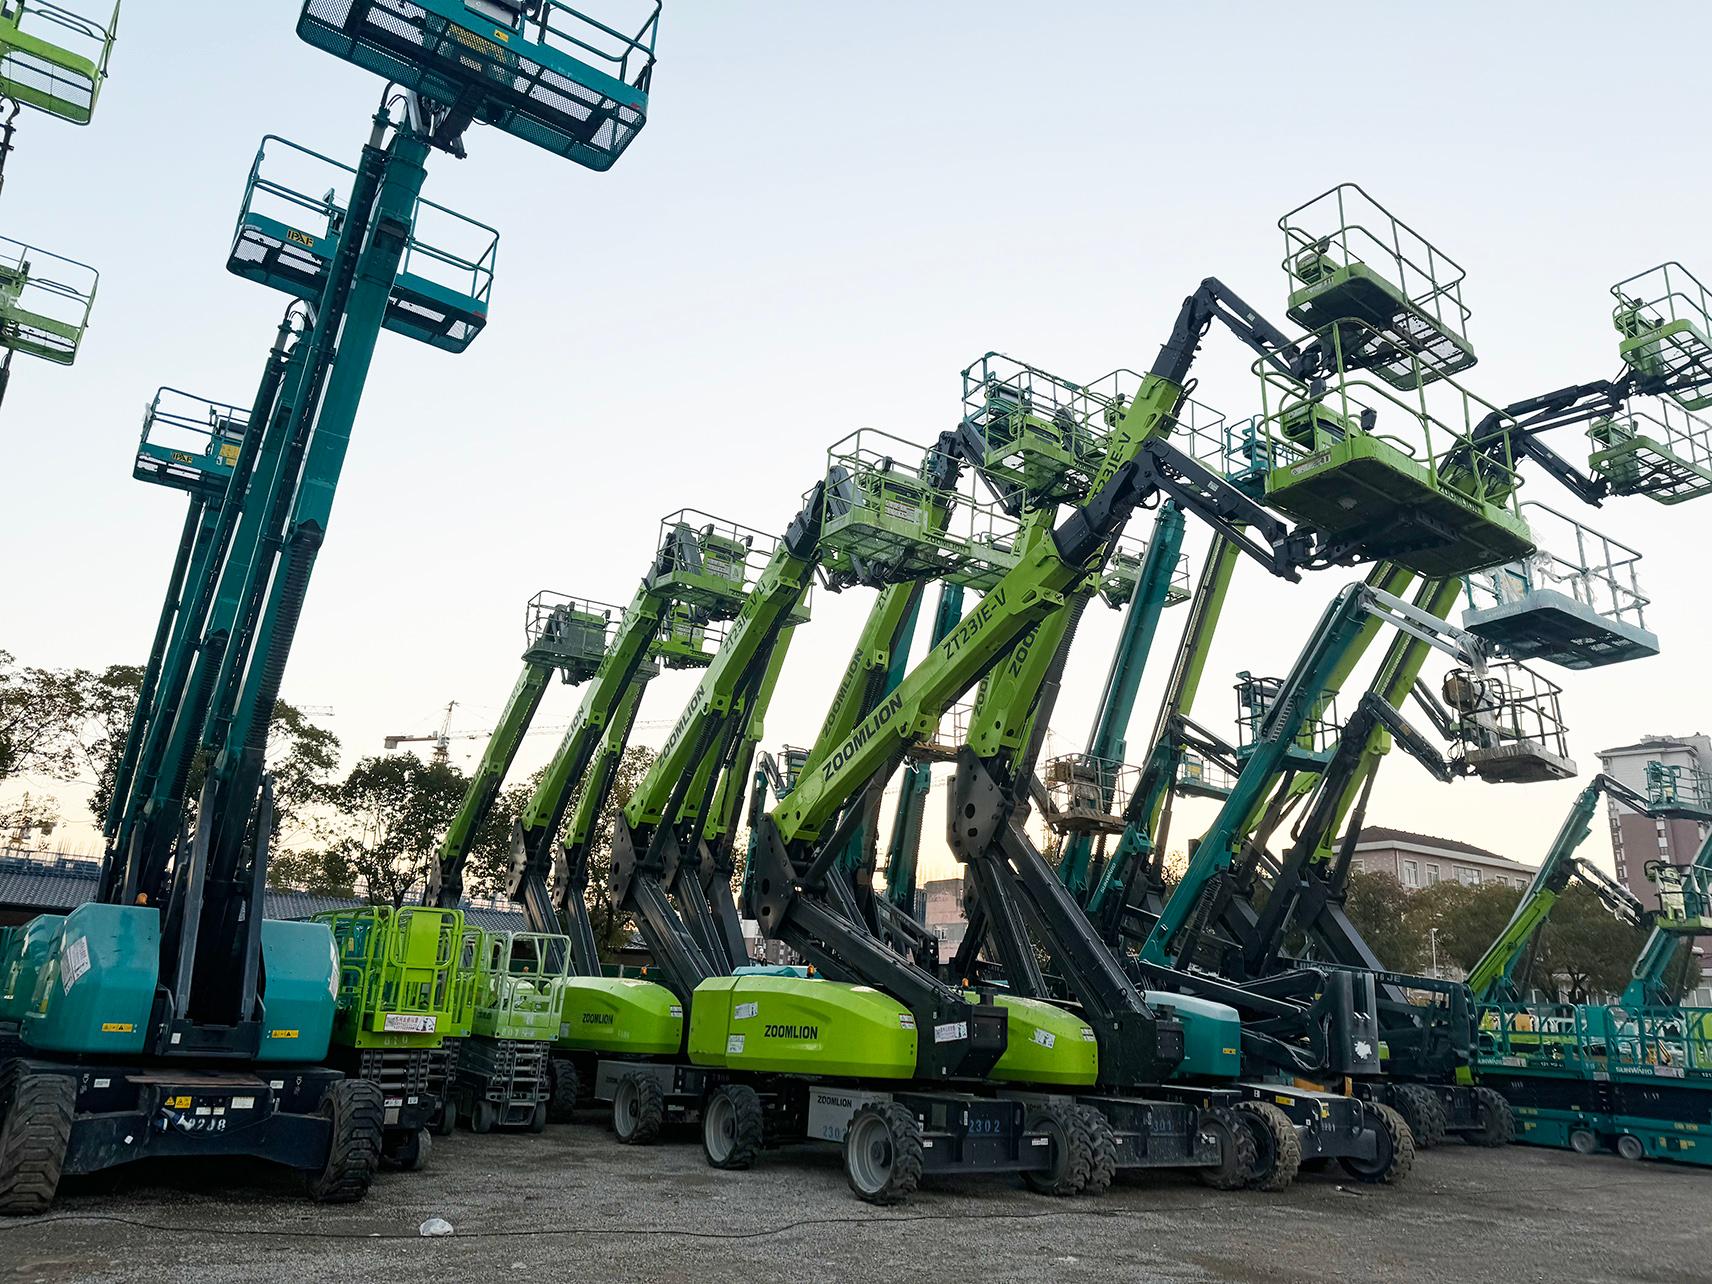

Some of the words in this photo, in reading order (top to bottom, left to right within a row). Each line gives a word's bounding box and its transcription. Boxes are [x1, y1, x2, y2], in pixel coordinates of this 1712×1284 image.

[287, 230, 314, 246] IPAF
[943, 587, 1007, 660] ZT23JE-V
[822, 647, 864, 738] ZOOMLION
[657, 685, 706, 768] ZOOMLION
[546, 705, 586, 778] ZOOMLION
[822, 692, 904, 781] ZOOMLION
[582, 1013, 614, 1025] ZOOMLION
[764, 1025, 818, 1040] ZOOMLION
[817, 1095, 852, 1108] ZOOMLION
[822, 1125, 846, 1138] 230
[968, 1120, 1000, 1133] 2302
